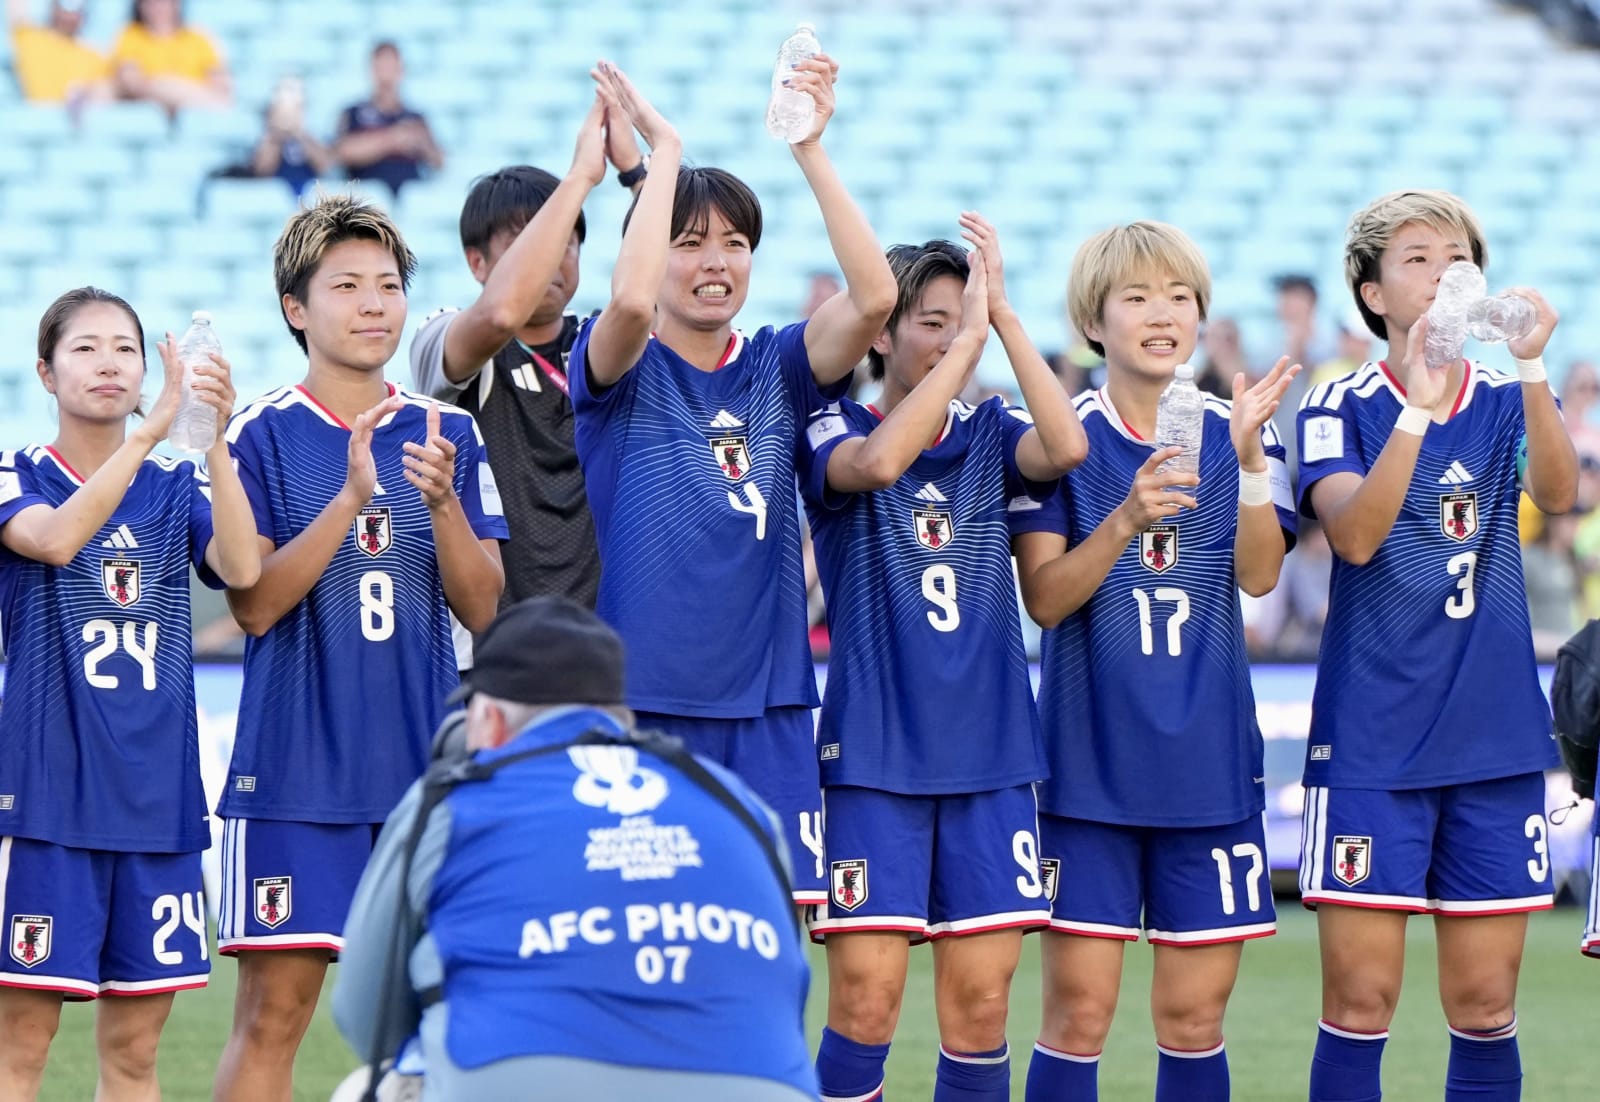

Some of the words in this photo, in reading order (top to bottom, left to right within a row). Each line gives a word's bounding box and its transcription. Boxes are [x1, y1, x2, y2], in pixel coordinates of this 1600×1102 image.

[728, 482, 766, 540] 4
[359, 571, 395, 641] 8
[921, 564, 960, 632] 9
[1445, 552, 1476, 619] 3
[82, 619, 157, 690] 24
[1132, 587, 1190, 656] 17
[799, 812, 823, 878] 4
[1012, 830, 1043, 898] 9
[1212, 843, 1263, 915] 17
[1524, 814, 1549, 882] 3
[152, 891, 207, 965] 24
[519, 907, 616, 959] AFC
[625, 902, 779, 960] PHOTO
[635, 945, 691, 984] 07
